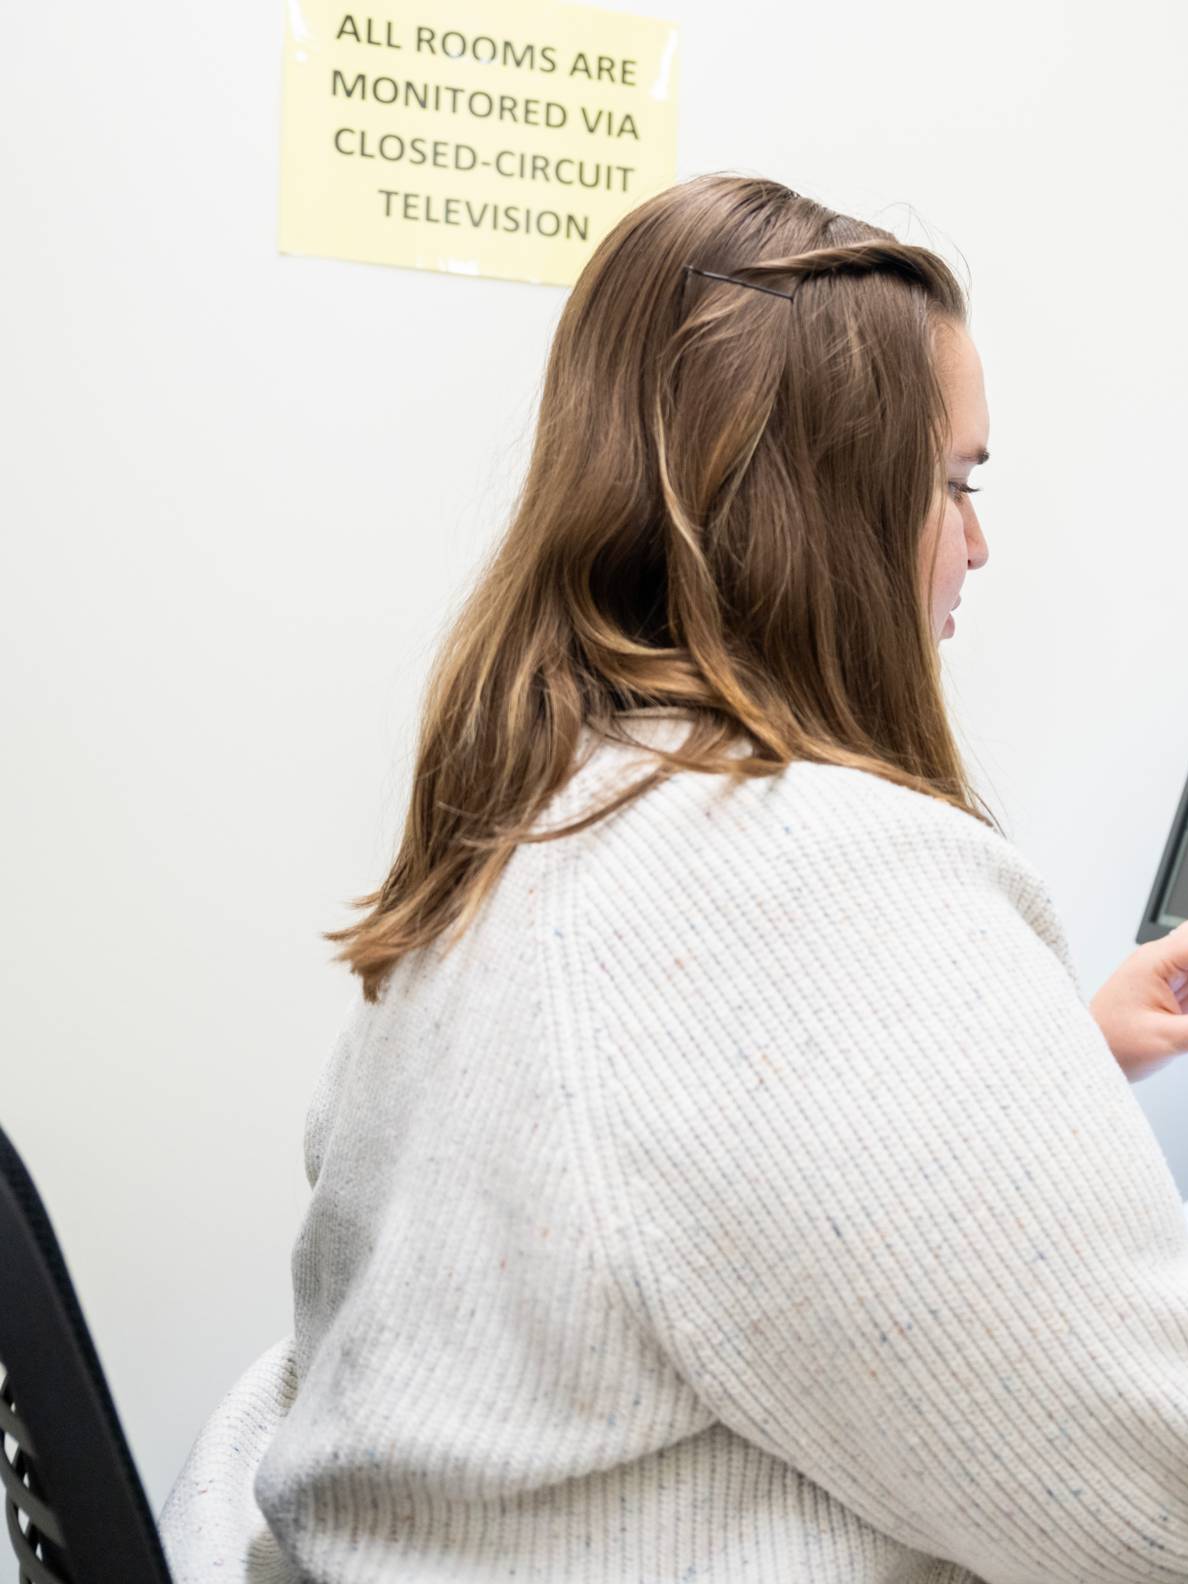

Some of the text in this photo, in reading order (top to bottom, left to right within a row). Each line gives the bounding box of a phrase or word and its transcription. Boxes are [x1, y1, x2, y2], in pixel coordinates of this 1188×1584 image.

[336, 14, 638, 87] ALL ROOMS ARE
[331, 69, 640, 141] MONITORED VIA
[334, 127, 636, 193] CLOSED-CIRCUIT
[377, 189, 590, 242] TELEVISION
